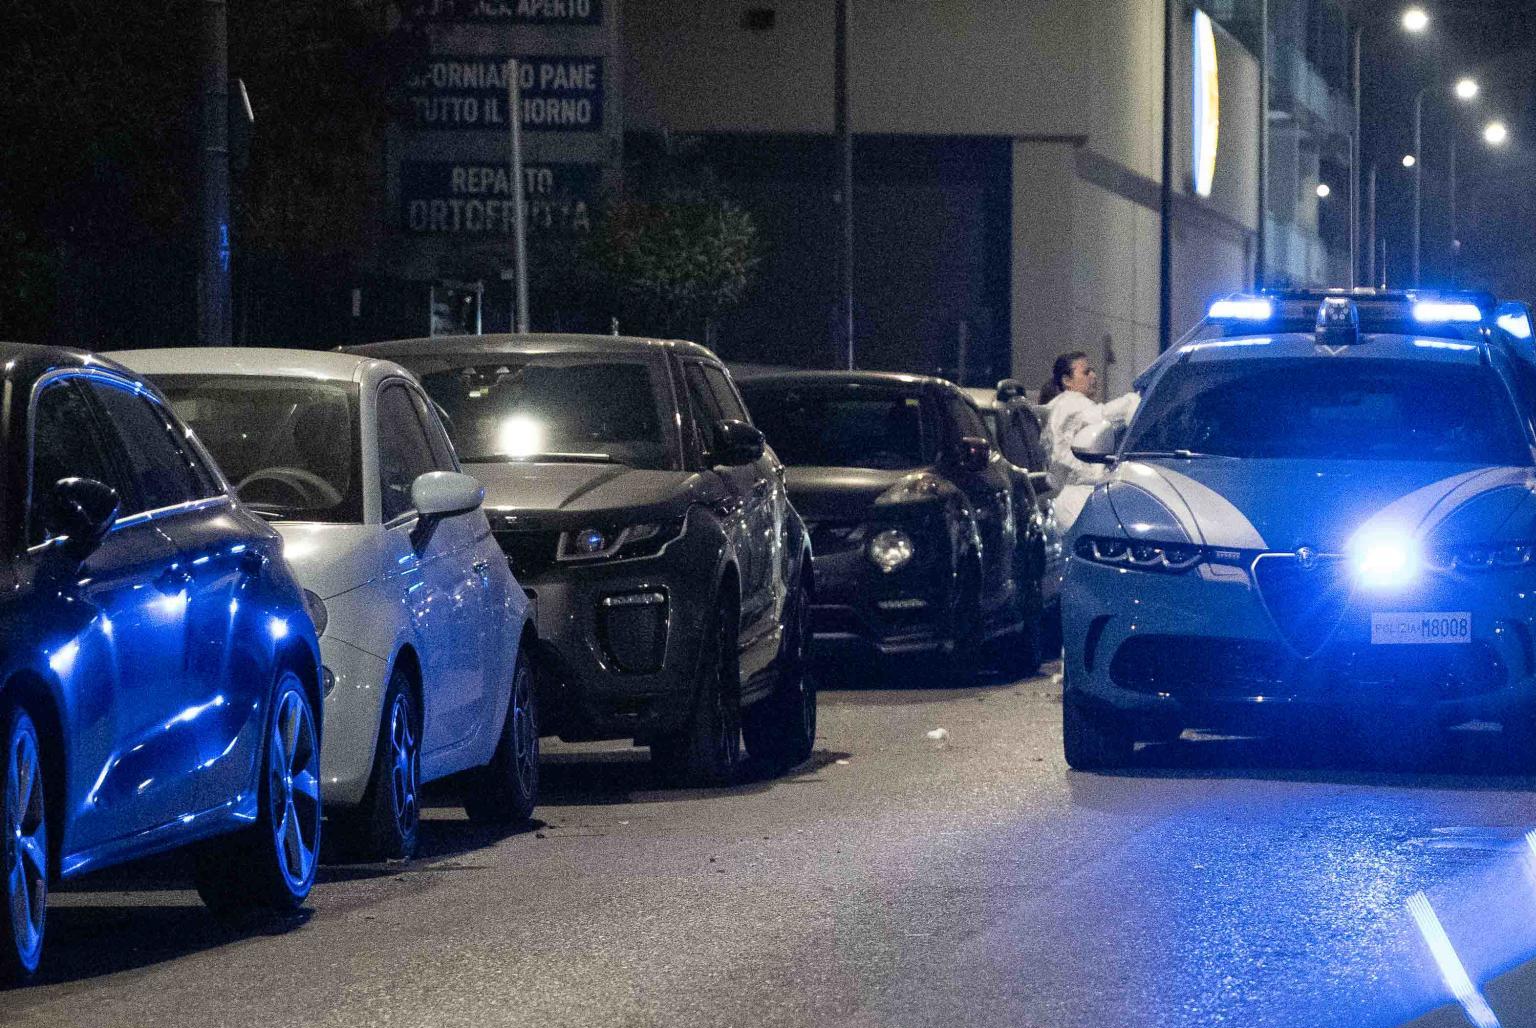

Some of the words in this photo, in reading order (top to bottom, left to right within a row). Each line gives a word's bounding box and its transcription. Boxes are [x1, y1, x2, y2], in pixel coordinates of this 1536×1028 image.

[517, 0, 591, 17] APERTO
[540, 63, 597, 90] PANE
[484, 97, 503, 123] IL
[510, 98, 591, 124] IORNO
[1375, 622, 1416, 634] POLIZIA
[1421, 618, 1468, 637] M8008
